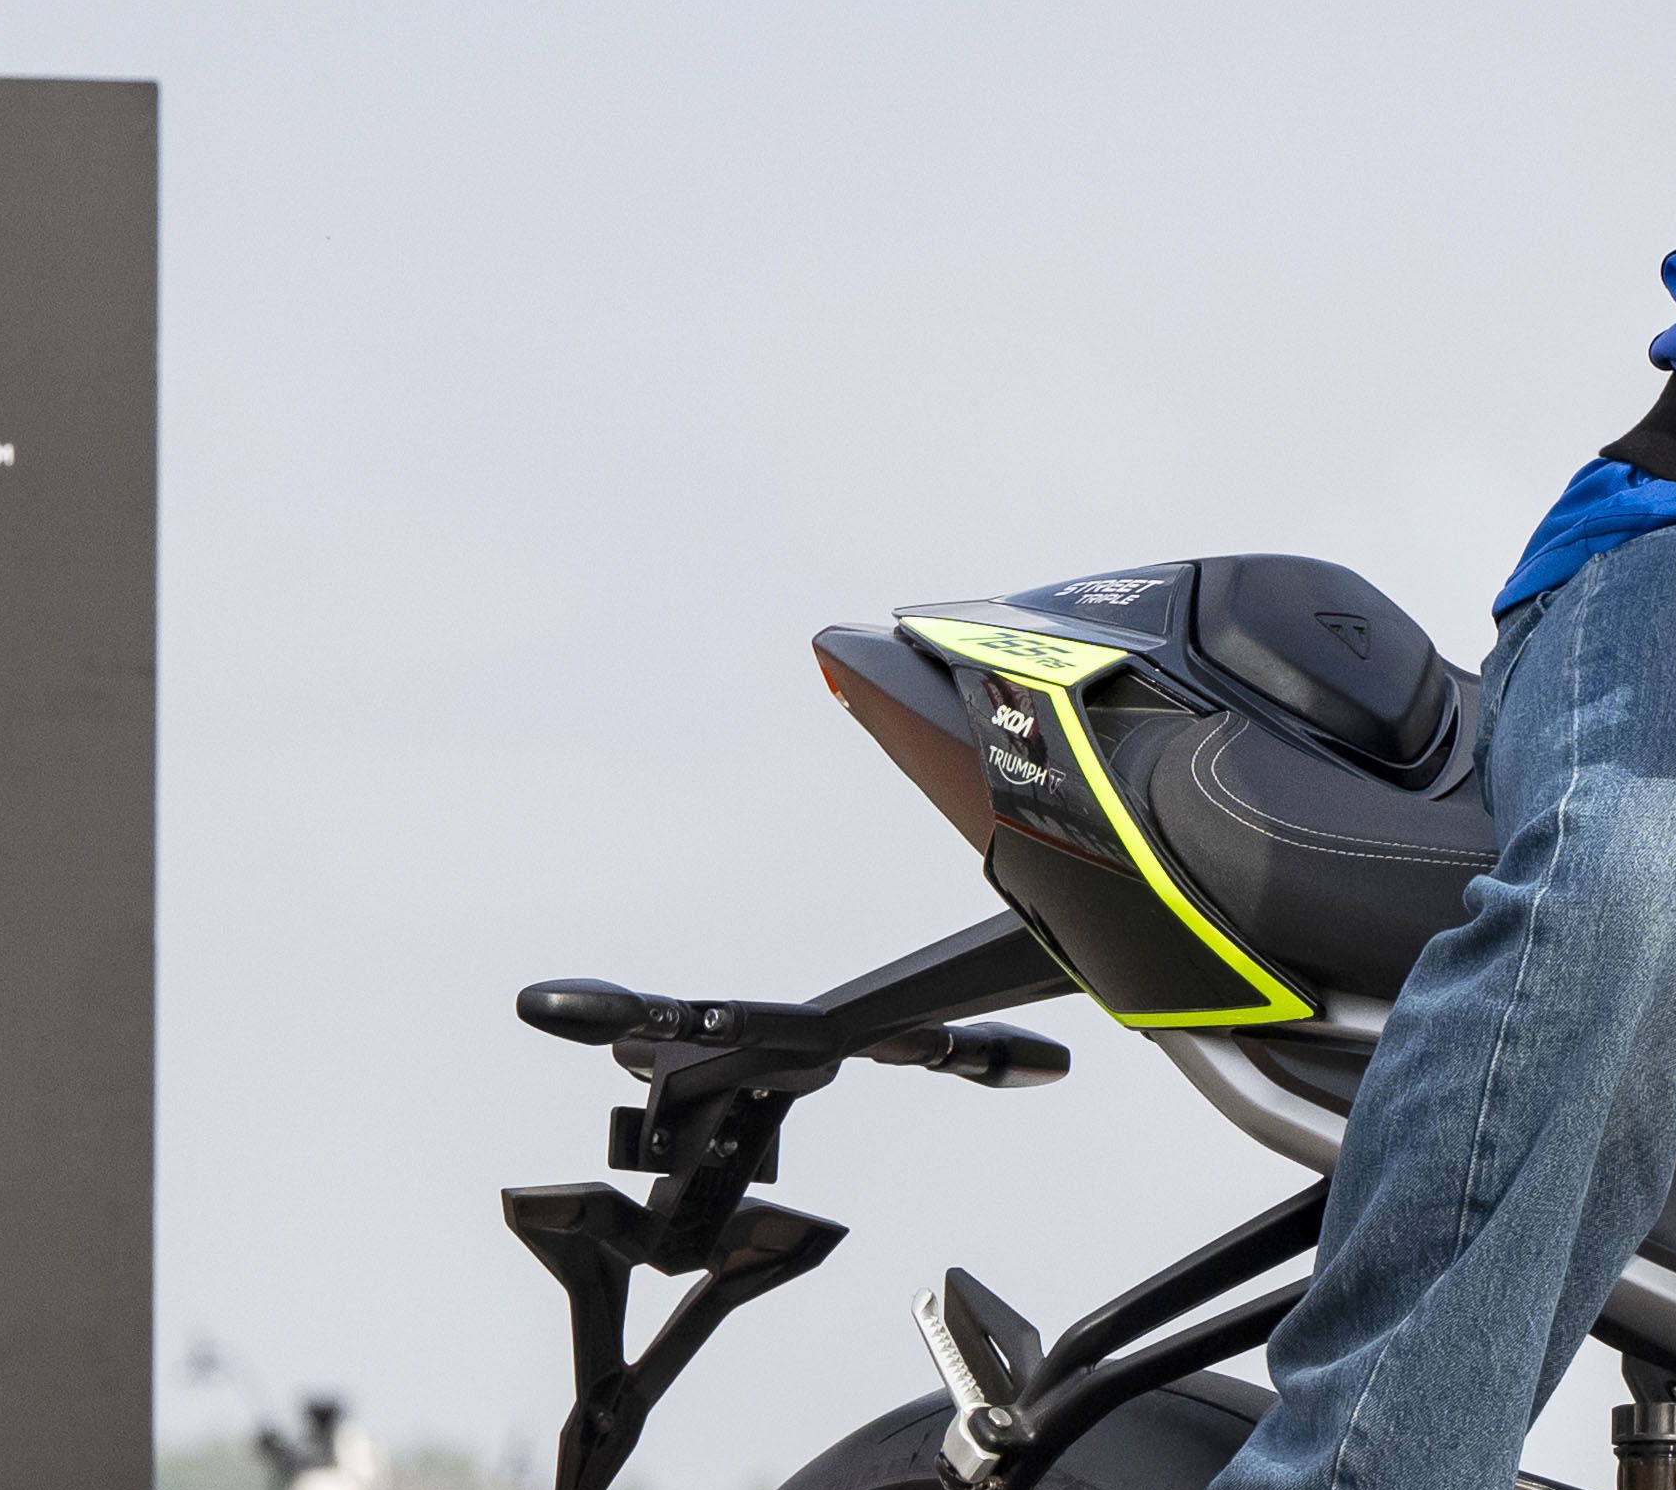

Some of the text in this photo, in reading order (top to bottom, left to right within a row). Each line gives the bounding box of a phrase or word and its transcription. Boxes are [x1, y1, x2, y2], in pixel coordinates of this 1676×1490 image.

[1053, 579, 1165, 596] STREET
[1075, 594, 1140, 606] TRIPLE
[958, 632, 1074, 656] 765
[988, 744, 1048, 786] TRIUMPH
